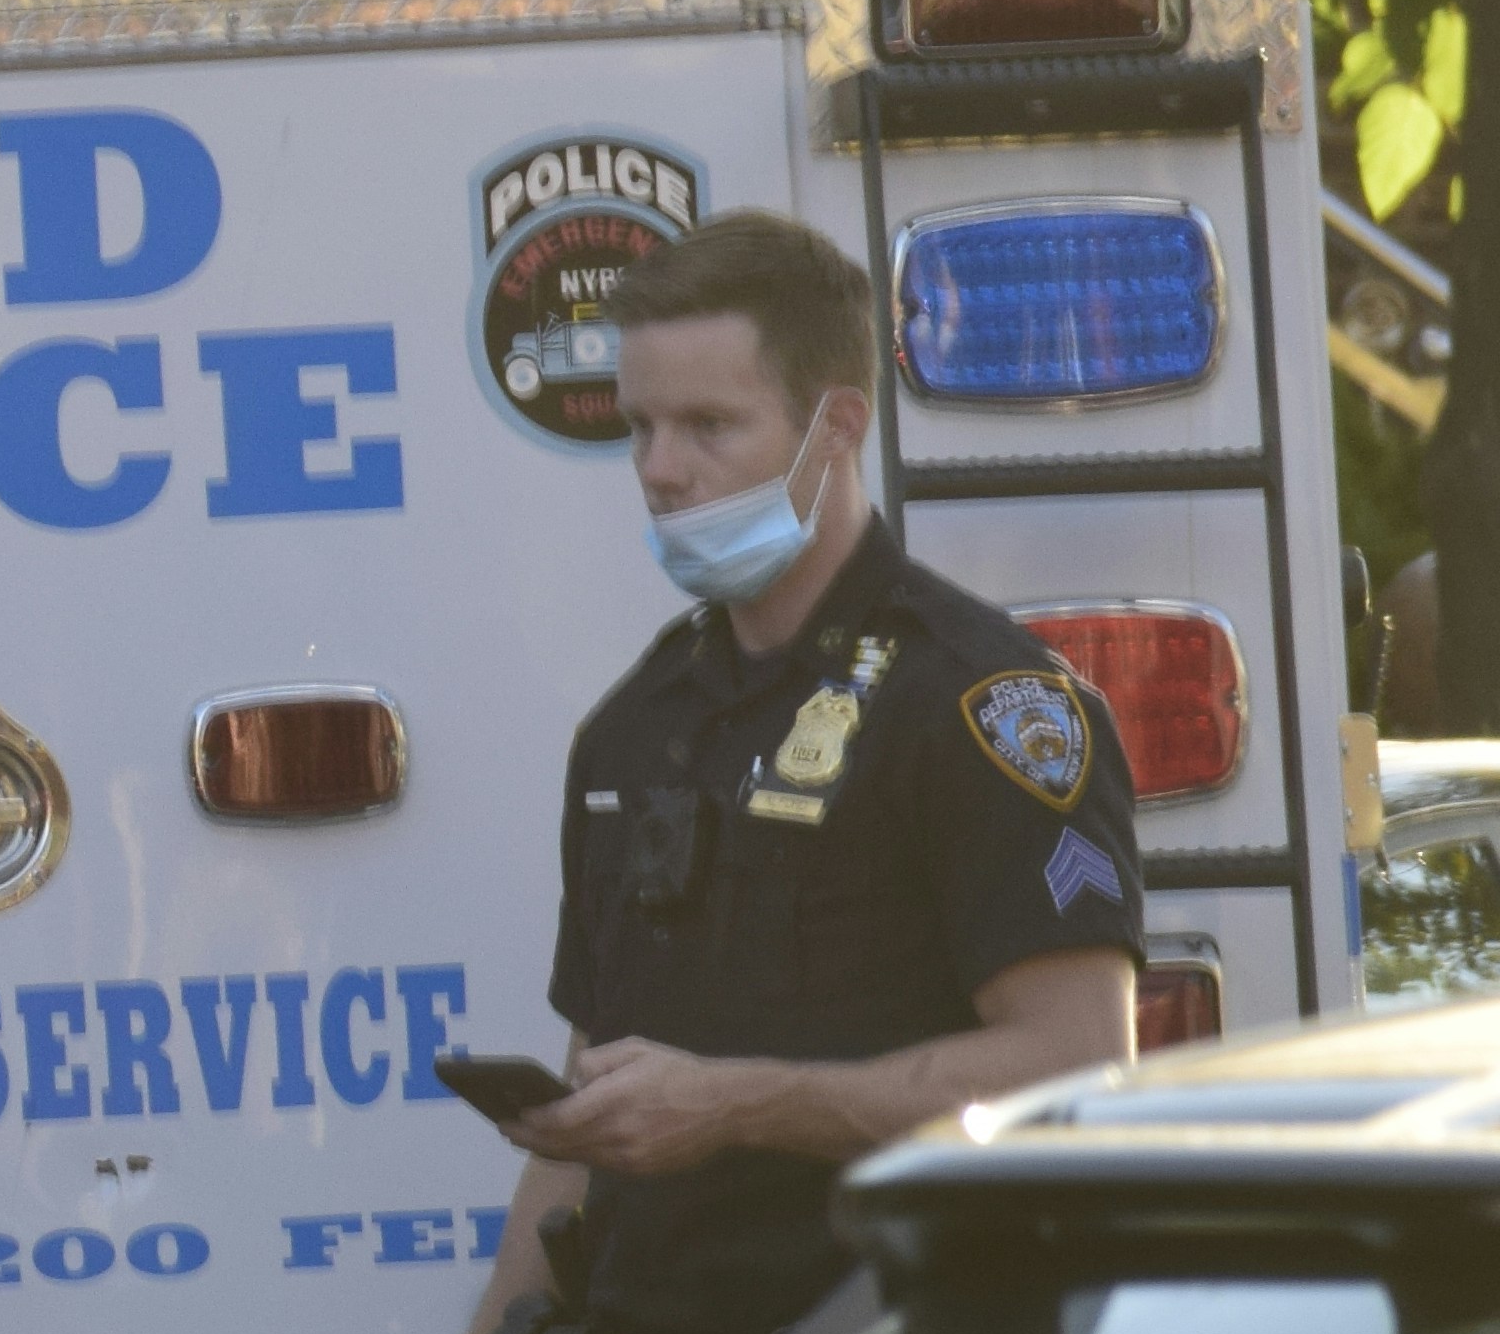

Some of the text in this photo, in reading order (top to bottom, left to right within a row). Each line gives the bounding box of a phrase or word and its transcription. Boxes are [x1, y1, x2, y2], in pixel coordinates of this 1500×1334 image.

[488, 143, 694, 241] POLICE
[560, 266, 625, 303] NYP
[989, 677, 1042, 701] POLICE
